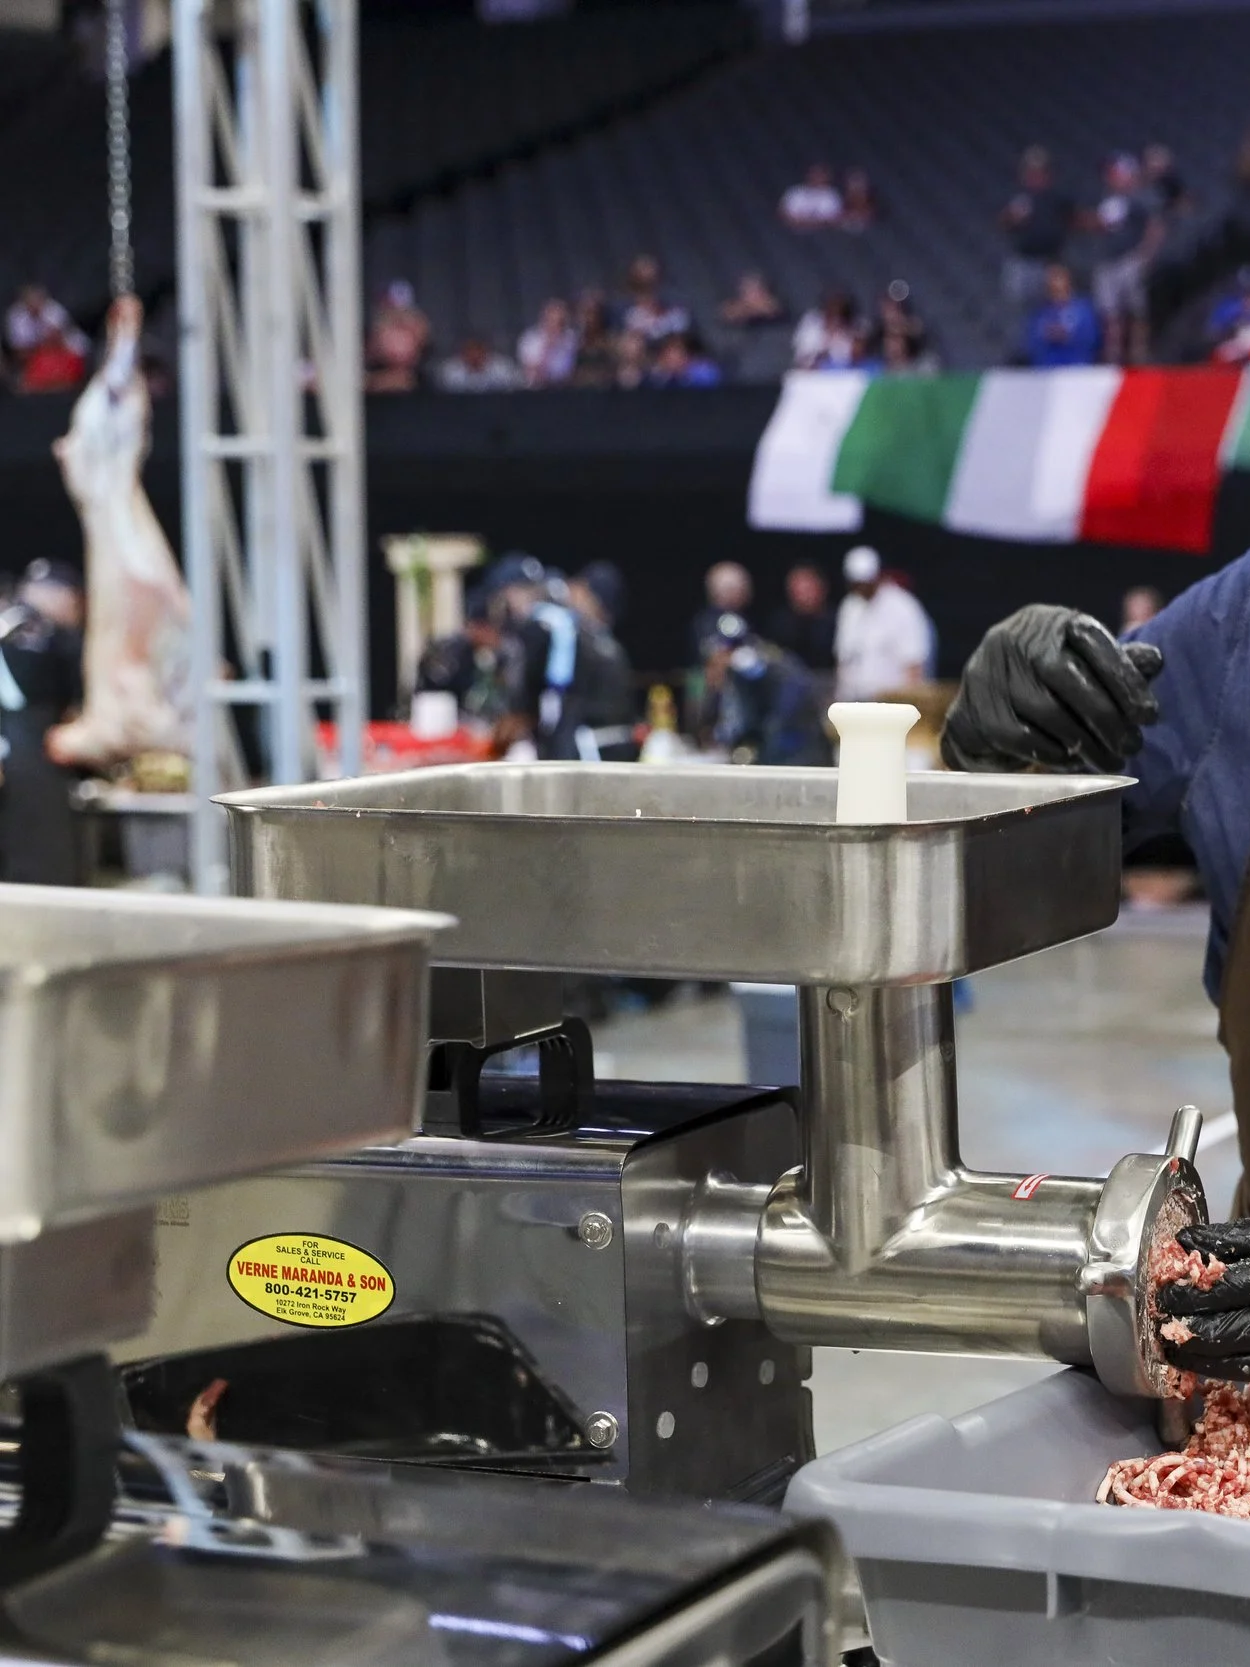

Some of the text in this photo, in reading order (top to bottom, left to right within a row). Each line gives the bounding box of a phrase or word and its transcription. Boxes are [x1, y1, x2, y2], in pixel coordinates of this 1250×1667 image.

[275, 1245, 302, 1256] SALES
[311, 1249, 345, 1260] SERVICE
[302, 1240, 319, 1249] FOR
[300, 1256, 321, 1266] CALL
[237, 1260, 387, 1292] VERNE MARANDA & SON
[265, 1282, 357, 1304] 800-421-5757
[275, 1299, 347, 1315] 10272 Iron Rock Way
[276, 1306, 346, 1322] Elk Grove, CA 95624
